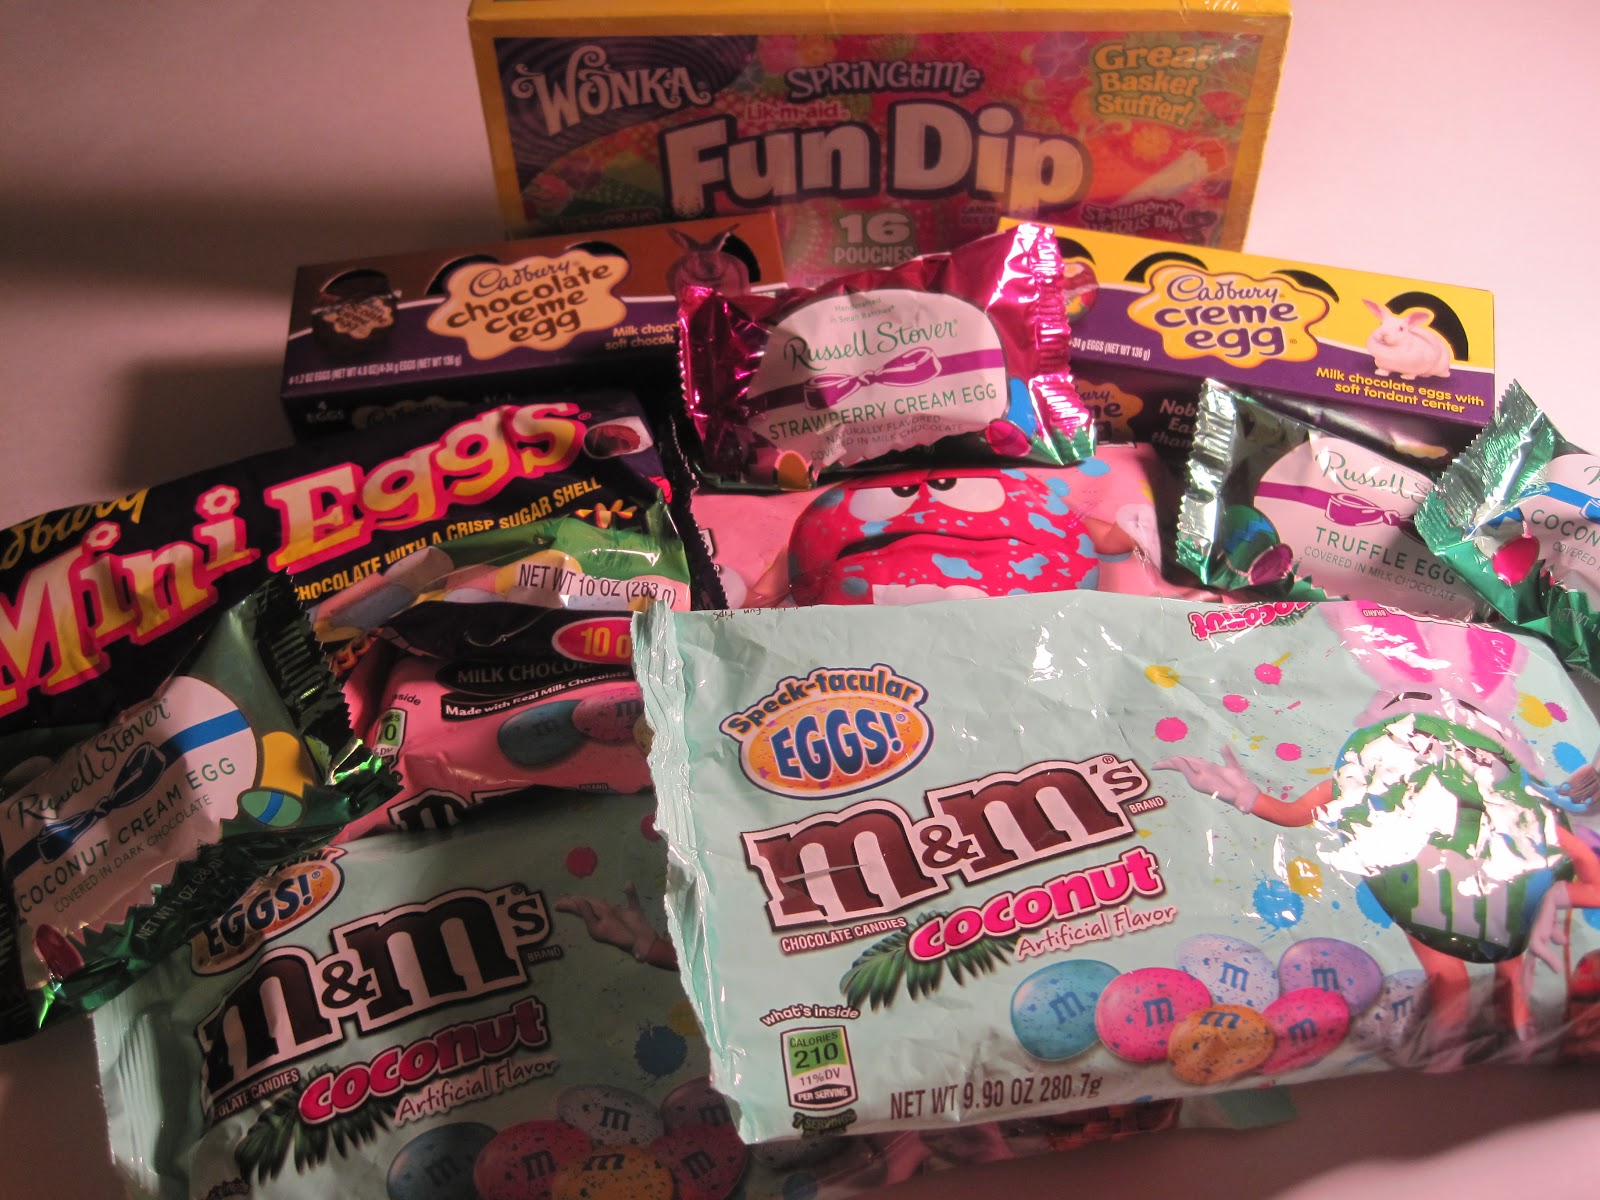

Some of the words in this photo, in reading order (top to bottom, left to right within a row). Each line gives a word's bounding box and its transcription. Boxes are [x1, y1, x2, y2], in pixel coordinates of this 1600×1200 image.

[1096, 43, 1214, 71] Great
[511, 45, 716, 137] WONKA
[1099, 71, 1199, 97] Basket
[1098, 94, 1194, 124] Stuffer!
[665, 118, 872, 217] Fun
[894, 102, 1084, 216] Dip
[839, 212, 910, 244] 16
[834, 246, 914, 265] POUCHES
[447, 264, 612, 328] chocolate
[469, 260, 570, 298] Cadbury
[1167, 274, 1279, 303] Cadbury
[485, 289, 588, 334] creme
[509, 308, 581, 342] egg
[1154, 300, 1299, 329] creme
[605, 337, 627, 350] soft
[613, 325, 638, 338] Milk
[784, 328, 871, 371] Russell
[877, 320, 956, 353] Stover
[1087, 339, 1104, 352] EGGS
[1120, 344, 1131, 356] WT
[1185, 326, 1285, 358] egg
[1316, 366, 1345, 381] Milk
[1348, 373, 1414, 393] chocolate
[1418, 387, 1452, 401] eggs
[1455, 393, 1485, 407] with
[1334, 383, 1360, 395] soft
[1363, 387, 1418, 405] fondant
[1421, 398, 1465, 414] center
[768, 402, 886, 441] STRAWBERRY
[894, 389, 956, 415] CREAM
[961, 383, 997, 404] EGG
[886, 415, 941, 432] FLAVORED
[857, 435, 869, 446] IN
[872, 432, 896, 444] MILK
[900, 422, 965, 439] CHOCOLATE
[1315, 450, 1408, 498] Russell
[294, 557, 382, 601] HOCOLATE
[385, 536, 427, 565] WITH
[432, 531, 442, 545] A
[446, 519, 494, 541] CRISP
[500, 499, 553, 529] SUGAR
[553, 476, 603, 508] SHELL
[1316, 526, 1407, 570] TRUFFLE
[1414, 559, 1455, 585] EGG
[1552, 541, 1597, 567] COVERED
[0, 484, 260, 713] Mini
[265, 401, 587, 573] Eggs
[1304, 546, 1352, 569] COVERED
[1354, 561, 1366, 573] IN
[1368, 565, 1391, 582] MILK
[1394, 574, 1457, 602] CHOCOLATE
[518, 563, 550, 587] NET
[552, 569, 576, 595] WT
[579, 574, 595, 597] 10
[600, 579, 620, 597] OZ
[581, 627, 611, 657] 10
[458, 661, 504, 684] MILK
[445, 704, 481, 716] Made
[484, 701, 510, 713] with
[513, 691, 539, 704] Real
[541, 683, 566, 697] Milk
[568, 671, 630, 687] Chocolate
[727, 668, 918, 736] Speck-tacular
[95, 701, 171, 774] Stover
[770, 708, 902, 781] EGGS!
[1128, 796, 1164, 815] BRAND
[20, 838, 110, 914] COCONUT
[117, 784, 182, 844] CREAM
[186, 757, 236, 790] EGG
[54, 876, 99, 913] COVERED
[101, 865, 113, 879] IN
[114, 843, 145, 869] DARK
[146, 794, 213, 847] CHOCOLATE
[135, 919, 160, 940] NET
[153, 905, 175, 920] WT
[178, 884, 198, 900] OZ
[202, 873, 313, 957] EGGS!
[781, 928, 852, 953] CHOCOLATE
[855, 918, 907, 939] CANDIES
[1018, 921, 1111, 957] Artificial
[1115, 906, 1177, 936] Flavor
[526, 946, 562, 962] BRAND
[761, 1004, 811, 1025] what's
[814, 1004, 859, 1018] inside
[789, 1031, 838, 1048] CALORIES
[794, 1042, 838, 1069] 210
[252, 1069, 299, 1098] CANDIES
[399, 1073, 489, 1121] Artificial
[496, 1057, 556, 1089] Flavor
[797, 1091, 814, 1100] PER
[814, 1087, 848, 1099] SERVING
[890, 1088, 929, 1120] NET
[931, 1084, 958, 1112] WT
[963, 1079, 1005, 1109] 9.90
[1011, 1076, 1034, 1105] OZ
[1040, 1073, 1103, 1103] 280.7g
[804, 1111, 856, 1129] SERVINGS
